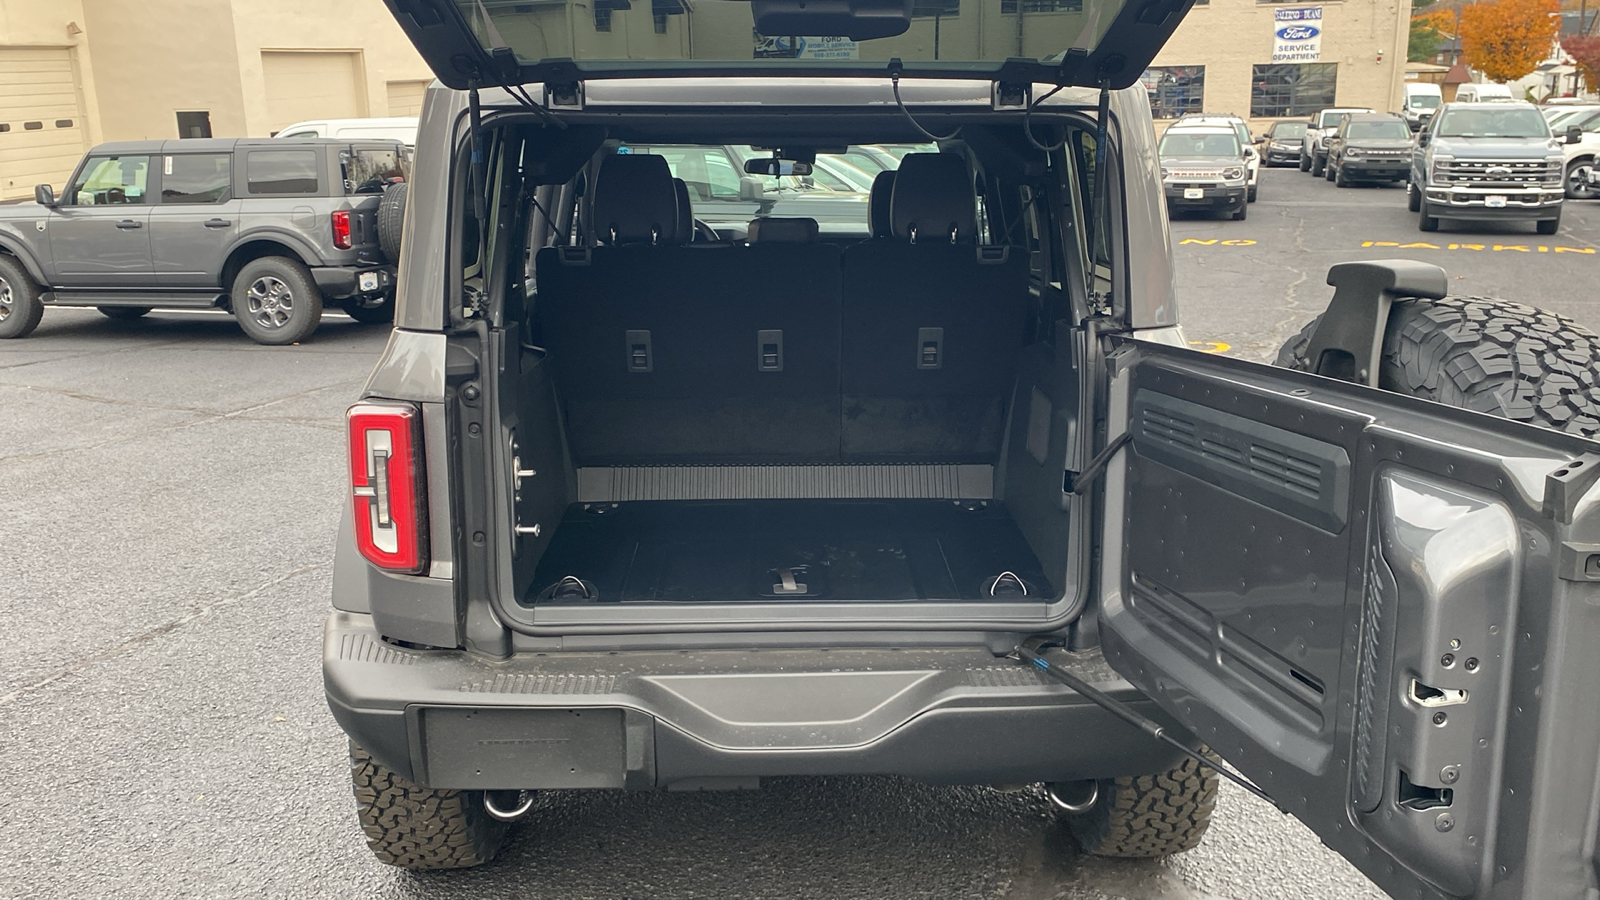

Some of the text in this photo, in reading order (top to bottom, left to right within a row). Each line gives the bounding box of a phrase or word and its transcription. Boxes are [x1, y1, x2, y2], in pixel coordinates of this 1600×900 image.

[1282, 26, 1313, 39] Ford
[1278, 44, 1316, 52] SERVICE
[1272, 53, 1320, 61] DEPARTMENT
[1179, 238, 1258, 246] NO
[1361, 240, 1596, 254] PARKIN
